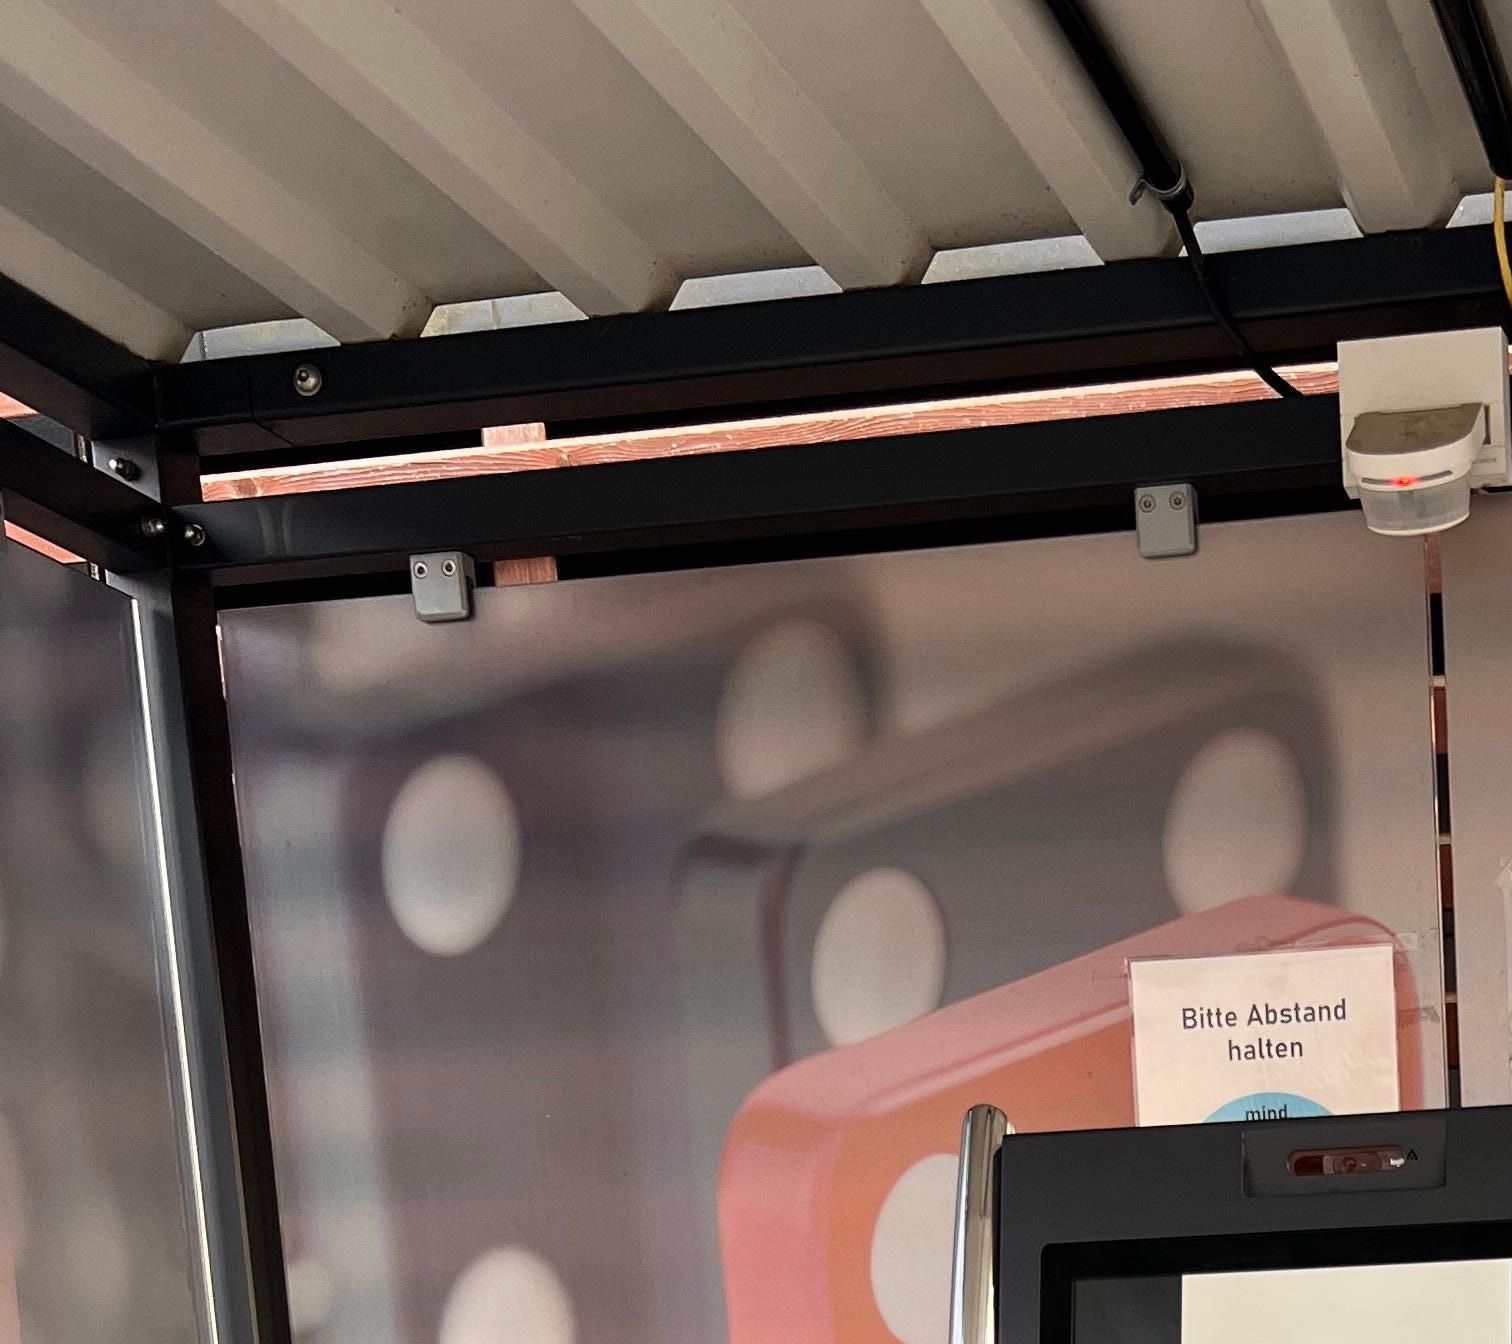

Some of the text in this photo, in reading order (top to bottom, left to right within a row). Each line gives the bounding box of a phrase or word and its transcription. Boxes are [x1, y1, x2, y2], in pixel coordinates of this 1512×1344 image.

[1182, 999, 1346, 1029] Bitte Abstand
[1228, 1038, 1303, 1061] halten
